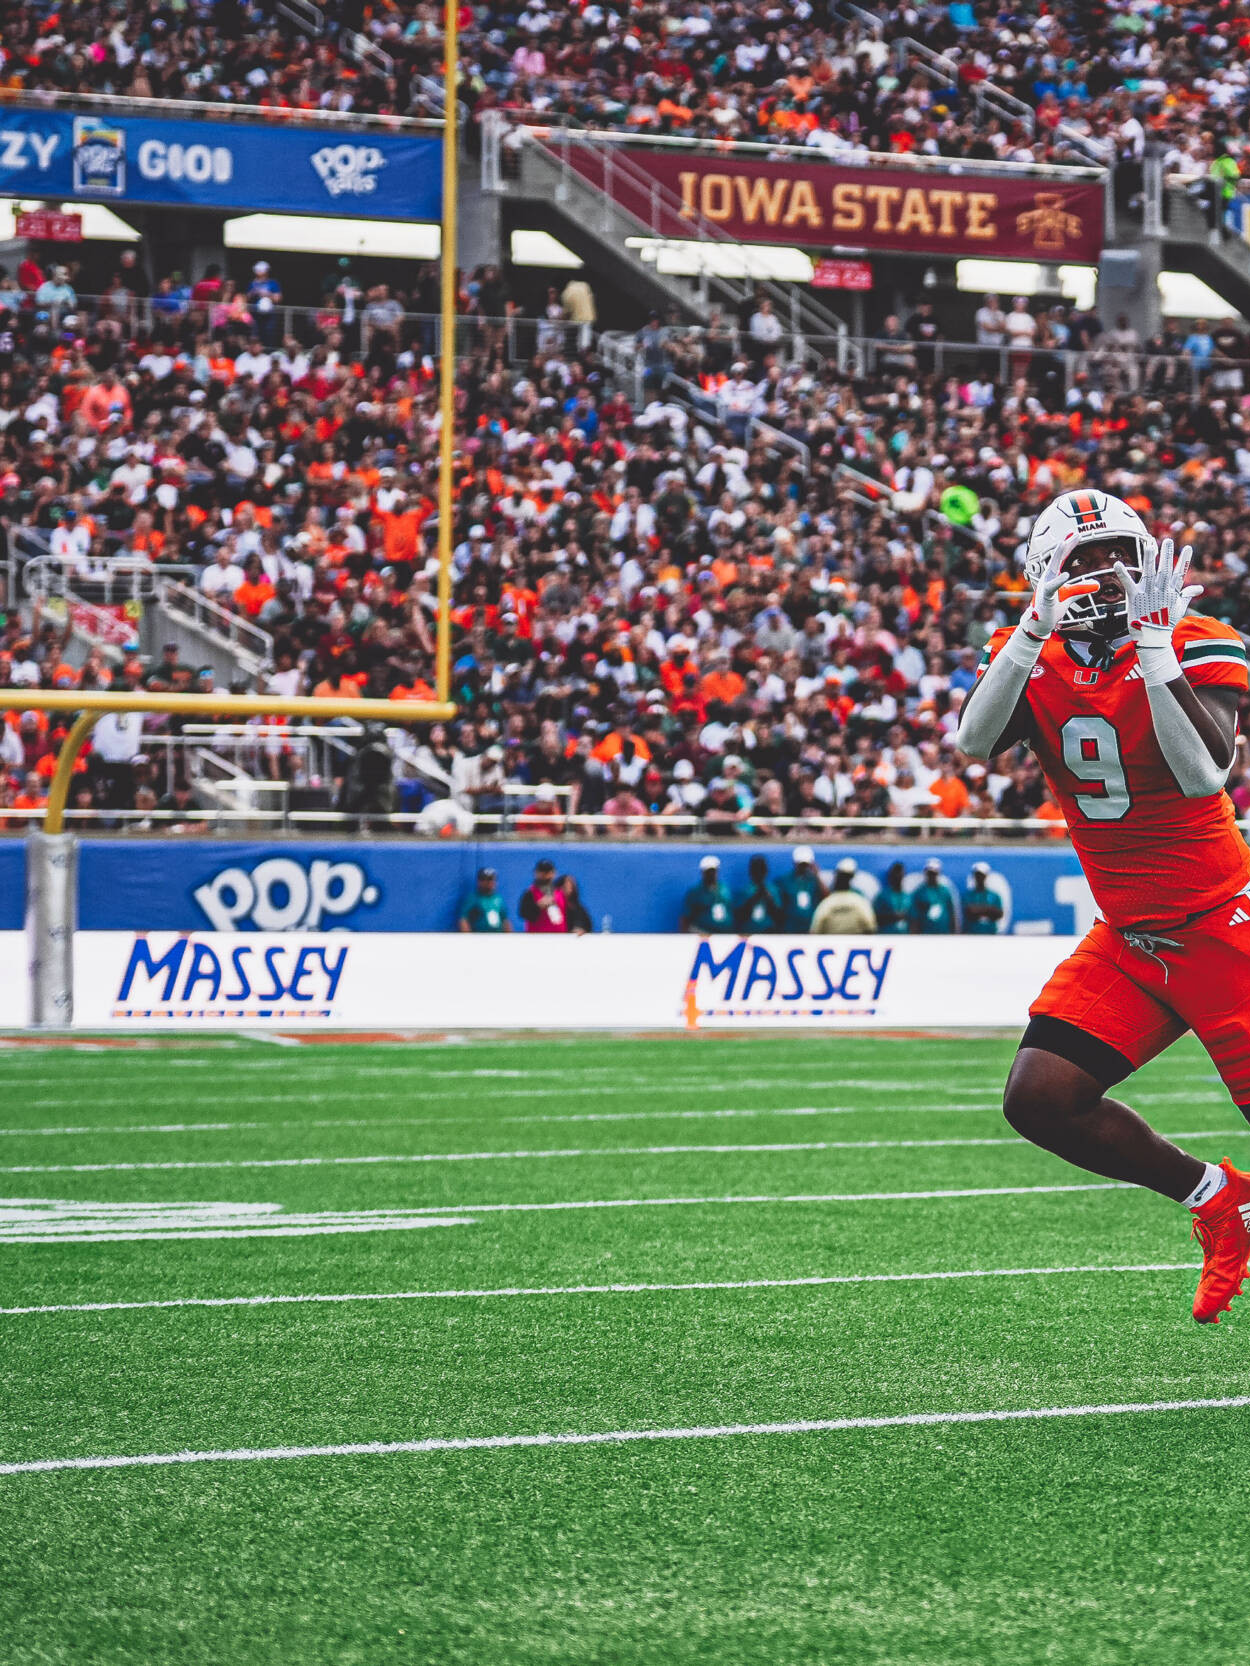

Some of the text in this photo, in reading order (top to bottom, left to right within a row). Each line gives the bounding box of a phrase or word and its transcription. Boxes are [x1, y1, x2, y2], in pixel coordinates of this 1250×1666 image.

[678, 172, 823, 228] IOWA
[832, 182, 998, 239] STATE
[1077, 522, 1107, 533] MIAMI
[1060, 715, 1131, 821] 9
[116, 938, 349, 1002] MASSEY
[687, 939, 893, 1002] MASSEY
